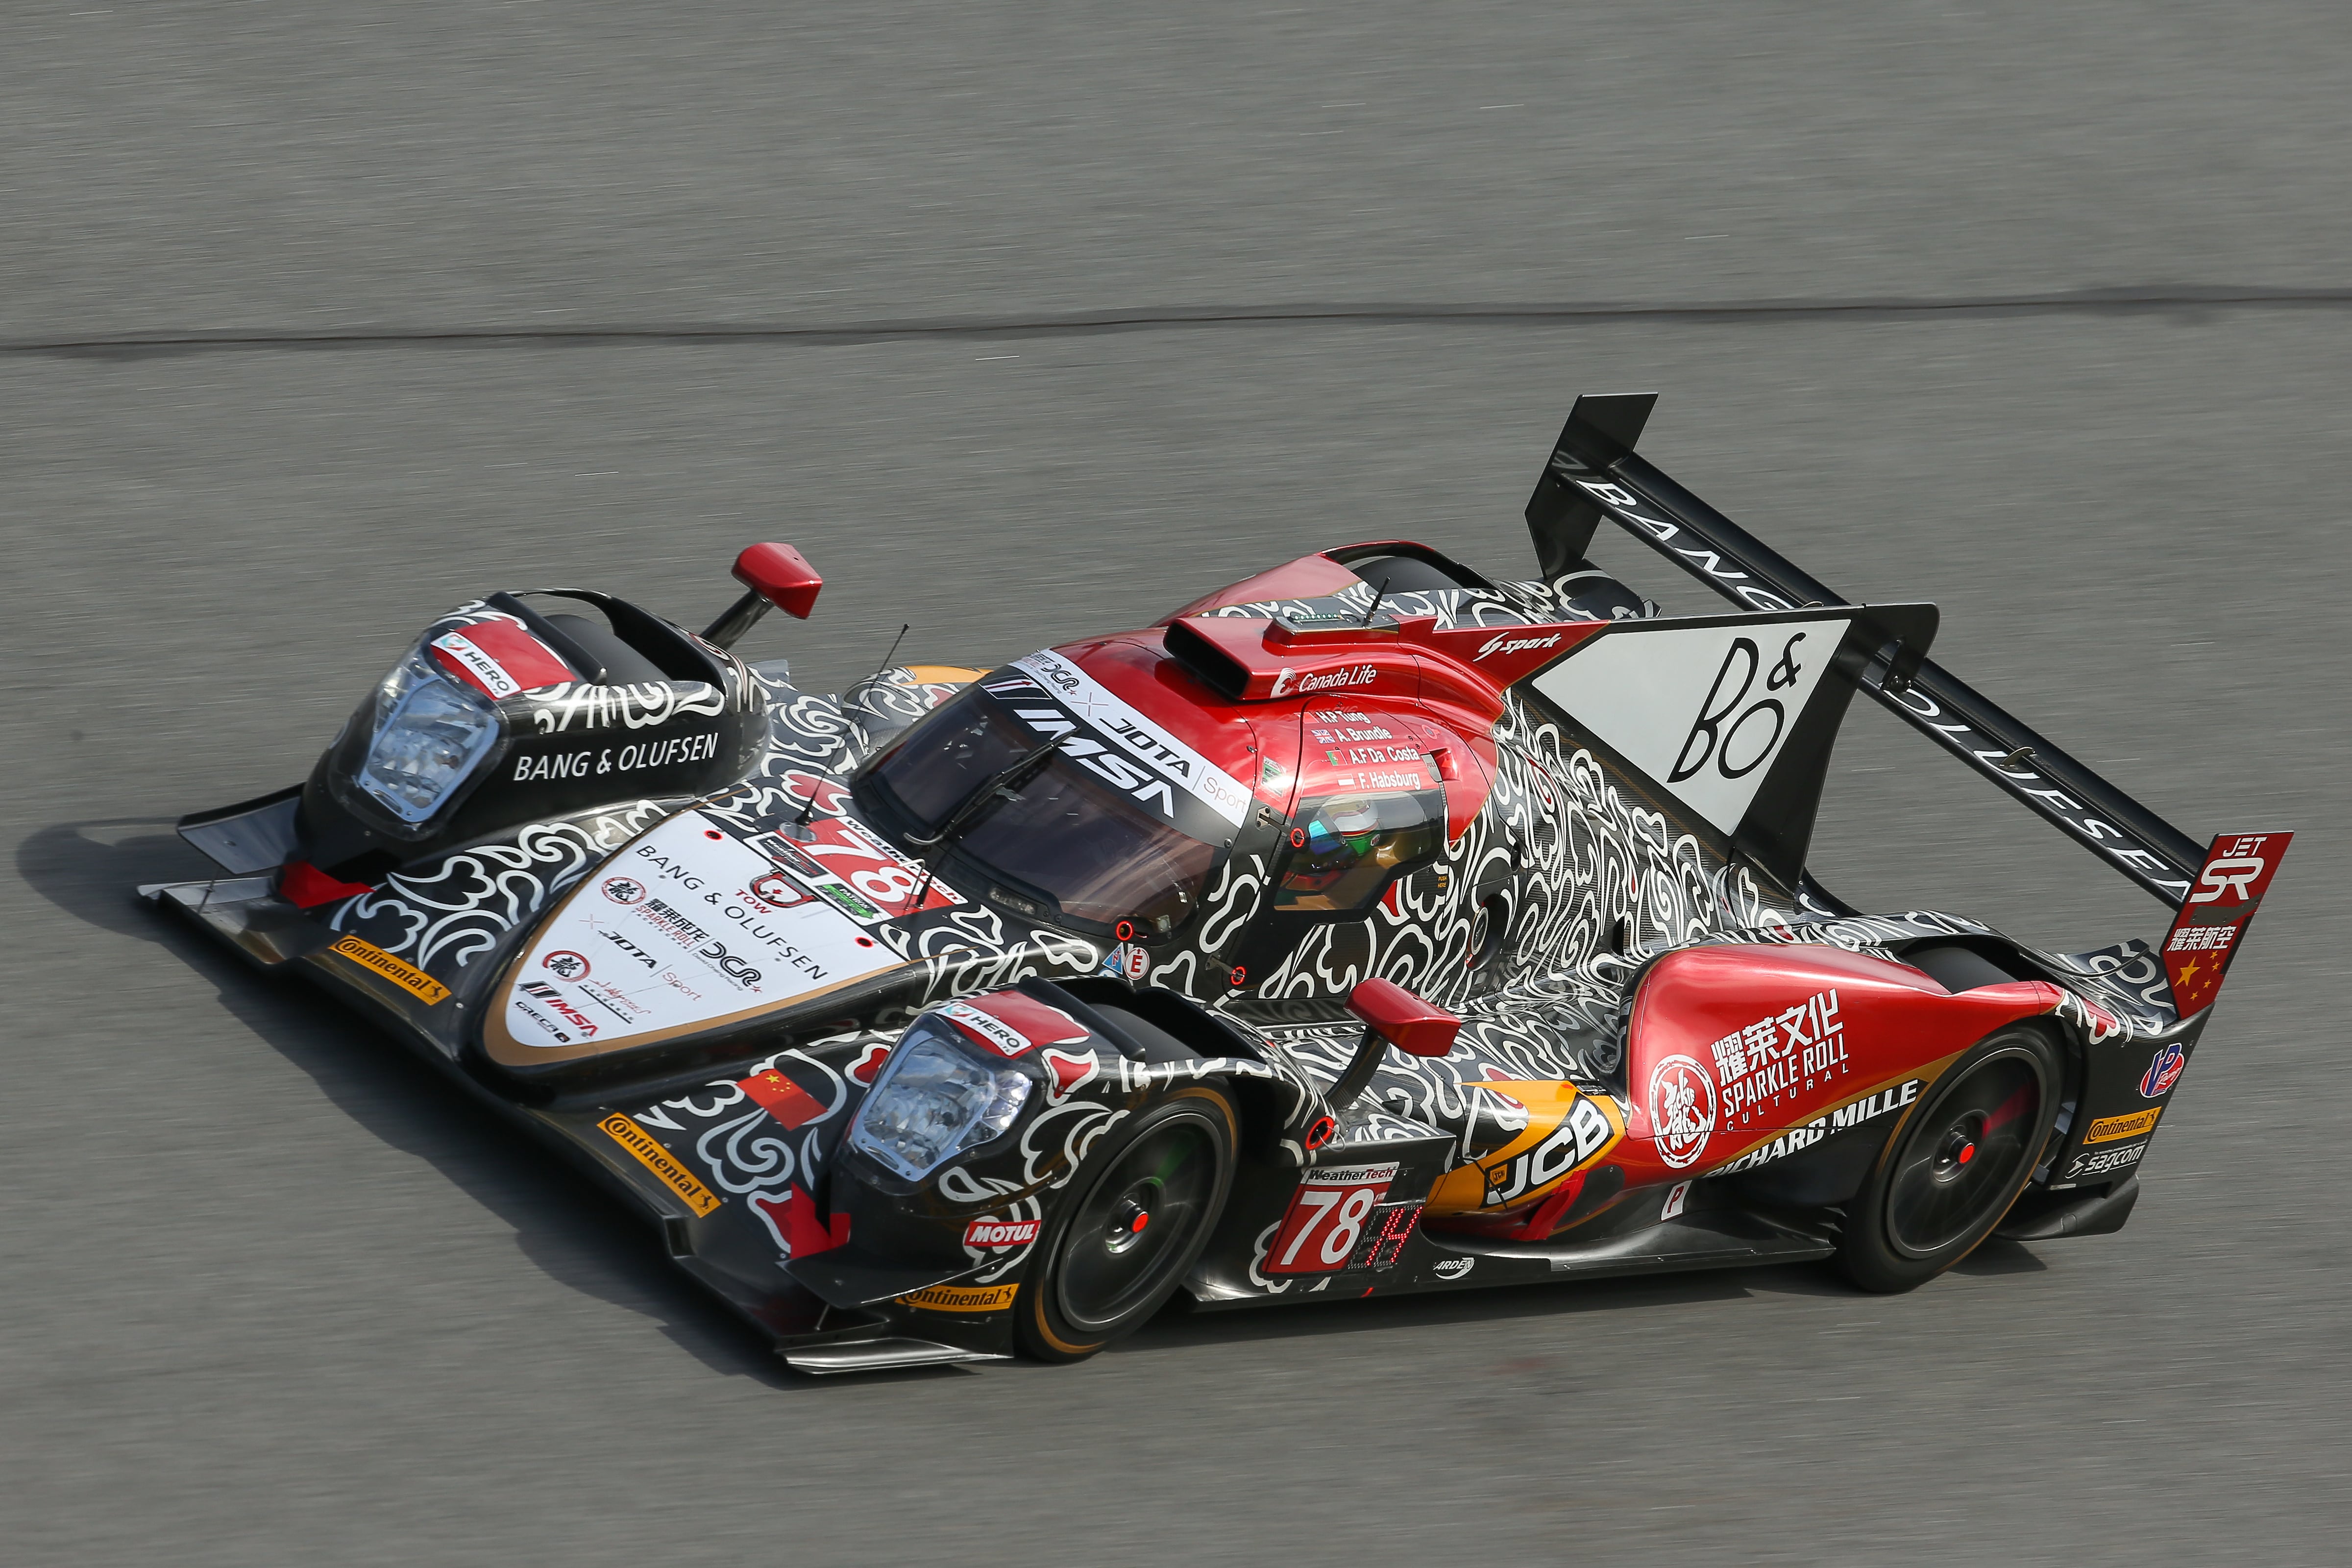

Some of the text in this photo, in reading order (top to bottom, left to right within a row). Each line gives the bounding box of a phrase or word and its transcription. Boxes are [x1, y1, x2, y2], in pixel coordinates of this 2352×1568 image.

[1576, 480, 1794, 611] BANG
[1499, 633, 1563, 655] spark
[465, 651, 509, 691] HERO
[1298, 664, 1377, 692] Canada Life
[1333, 726, 1393, 742] A. Brundle
[1334, 710, 1372, 724] Tung
[514, 732, 719, 781] BANG & OLUFSEN
[1013, 709, 1175, 819] IMSA
[1099, 718, 1192, 780] JOTA
[1202, 776, 1247, 815] Sport
[1367, 747, 1386, 763] Da
[1386, 746, 1421, 761] Costa
[1357, 770, 1421, 791] F. Habsburg
[802, 829, 925, 903] 78
[2223, 836, 2268, 857] JET
[636, 845, 829, 980] BANG & OLUFSEN
[735, 889, 773, 914] TOW
[635, 905, 696, 948] SPARKLE ROLL
[335, 938, 432, 991] Continental
[598, 930, 658, 969] JOTA
[662, 971, 702, 1001] Sport
[1130, 955, 1143, 973] E
[545, 999, 599, 1037] IMSA
[970, 1016, 1020, 1049] HERO
[1722, 1033, 1850, 1118] SPARKLE ROLL
[2144, 1043, 2182, 1097] VP
[1726, 1063, 1849, 1131] CULTURAL
[1830, 1079, 1918, 1135] MILLE
[2087, 1111, 2148, 1142] Continental
[604, 1116, 701, 1199] Continental
[1487, 1099, 1609, 1204] JCB
[2084, 1144, 2146, 1174] sagcom
[1310, 1167, 1394, 1181] WeatherTech
[1667, 1185, 1685, 1214] P
[969, 1223, 1036, 1244] MOTUL
[1280, 1188, 1374, 1266] 78
[1433, 1256, 1474, 1272] ARDEN
